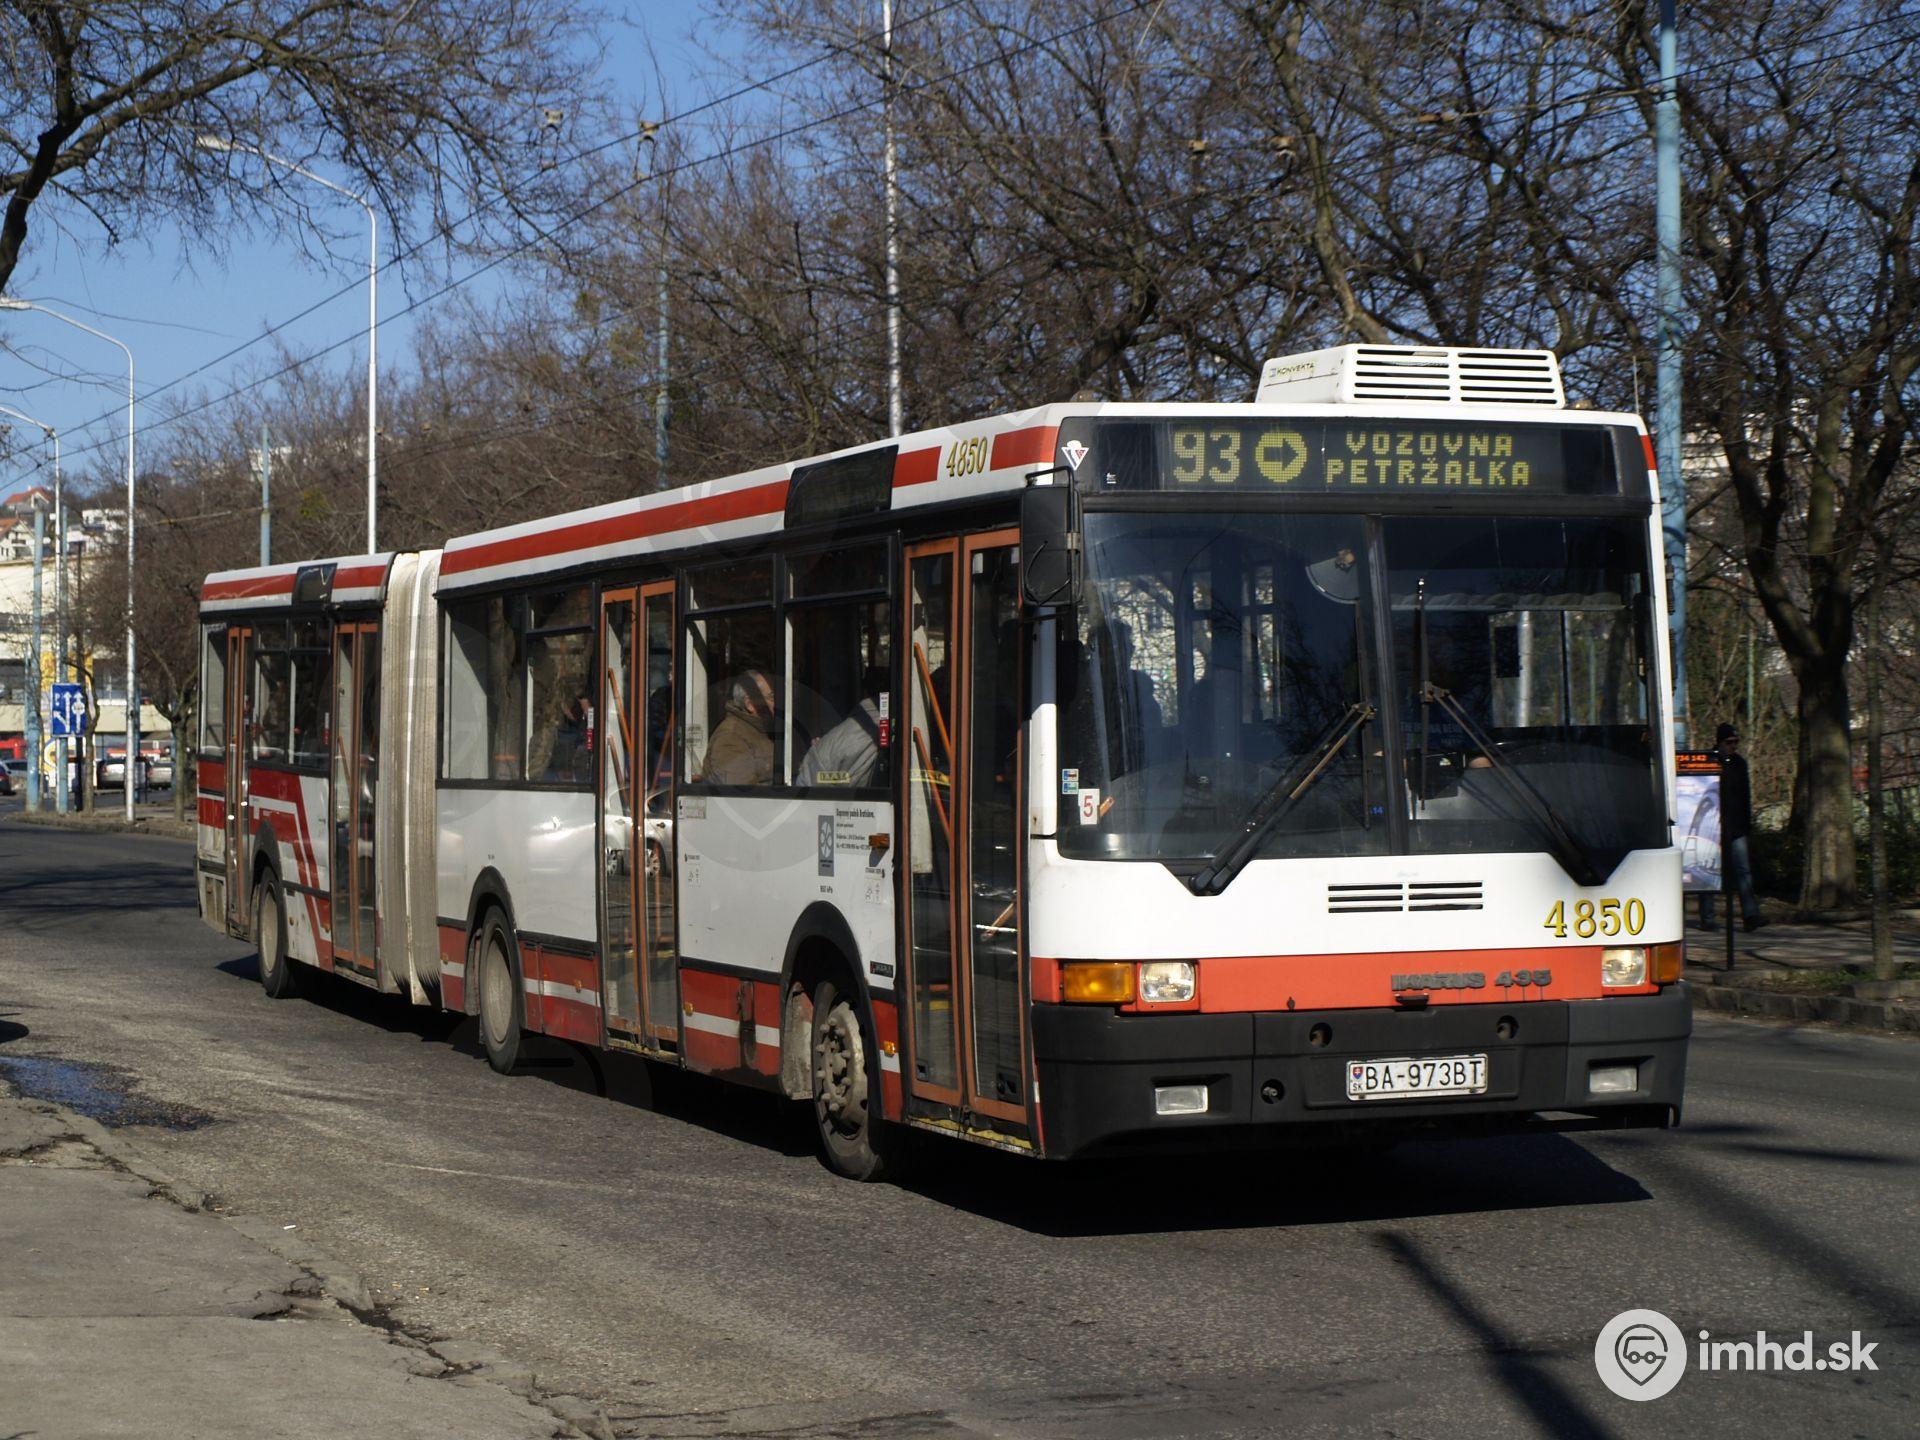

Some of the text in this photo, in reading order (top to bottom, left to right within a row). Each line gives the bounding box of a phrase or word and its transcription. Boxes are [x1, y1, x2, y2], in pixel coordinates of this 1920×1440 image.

[1276, 362, 1315, 375] KONVEKTA
[946, 436, 988, 477] 4850
[1173, 431, 1241, 482] 93
[1346, 431, 1513, 457] VOZOVNA
[1326, 457, 1530, 486] PETRŽALKA
[1083, 795, 1093, 818] 5
[1543, 897, 1646, 938] 4850
[1391, 969, 1552, 991] IKARUS 435
[1352, 1082, 1363, 1092] SK
[1365, 1061, 1482, 1090] BA-973BT
